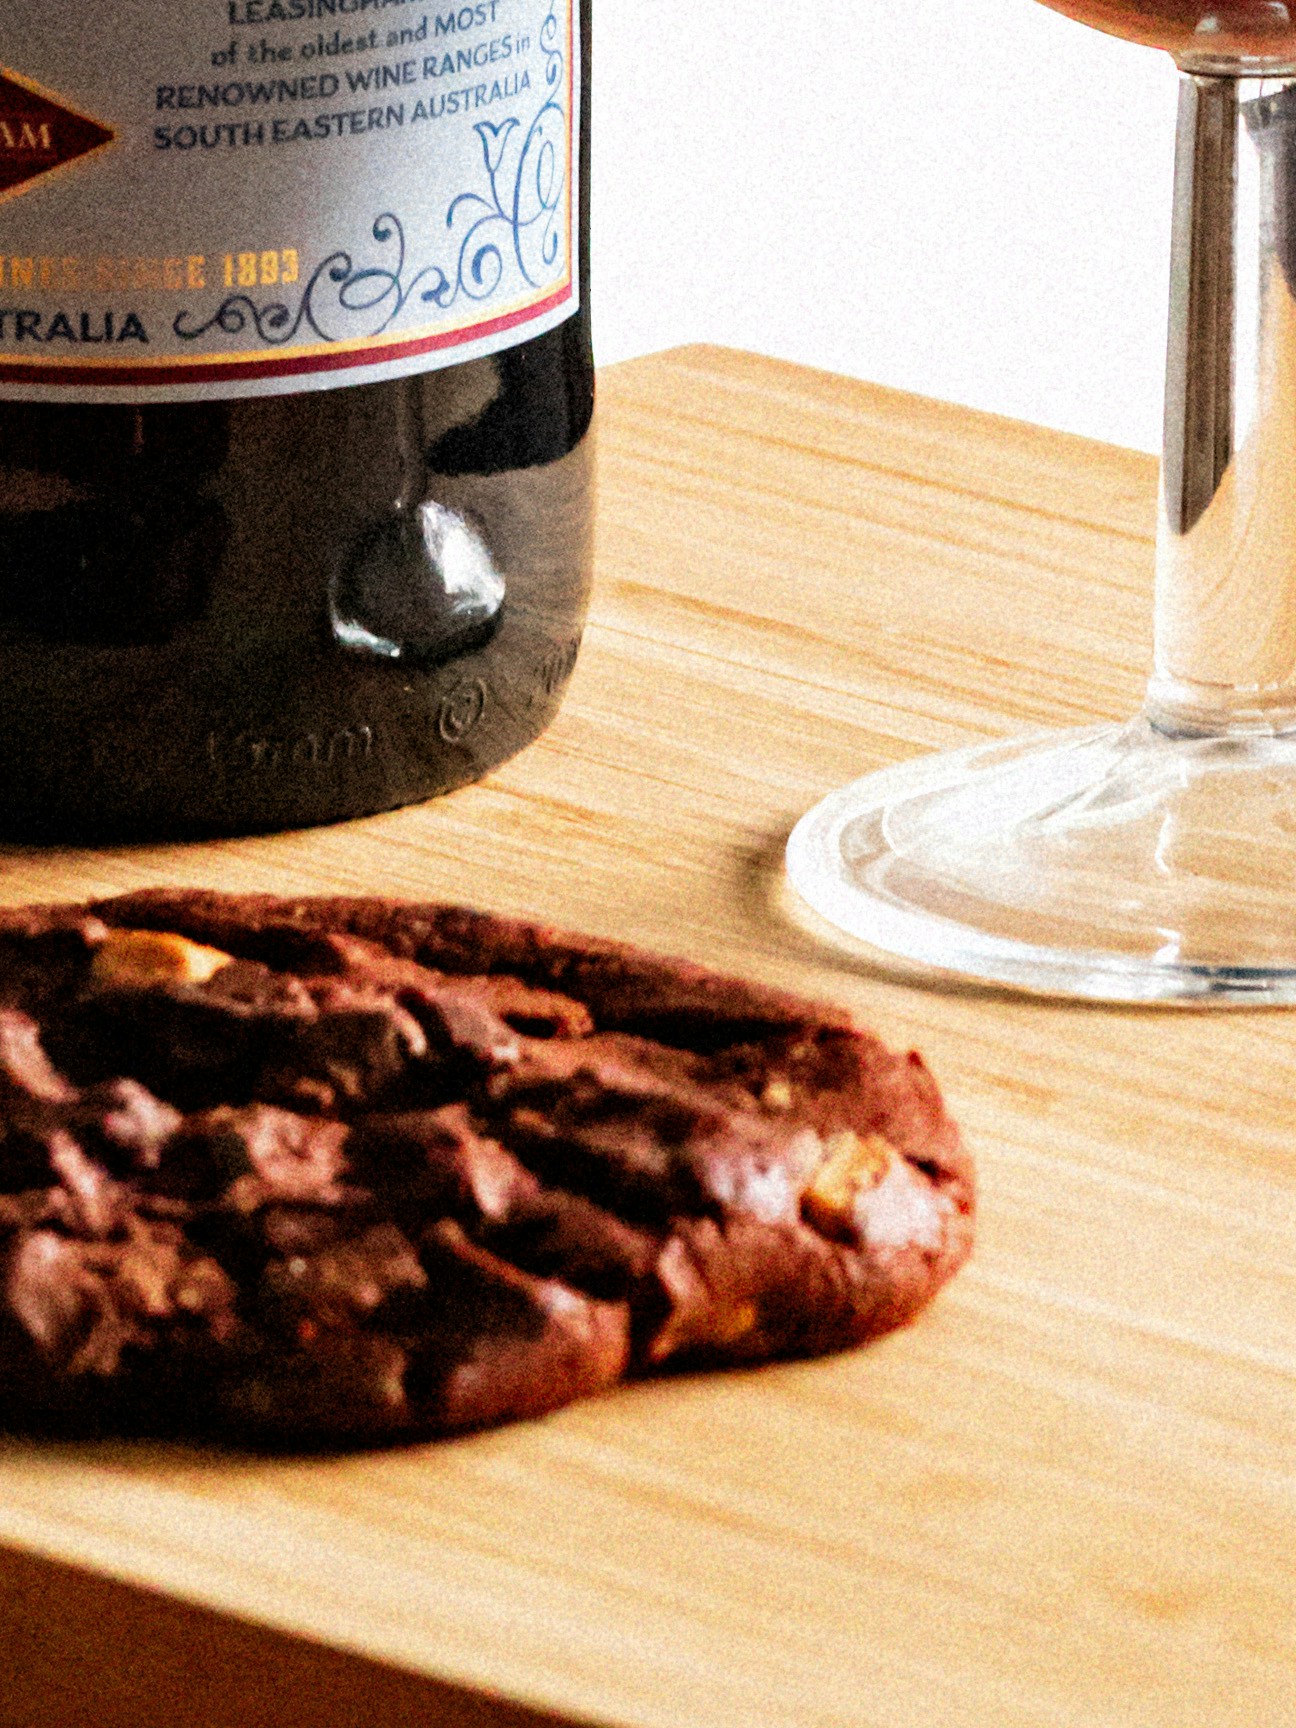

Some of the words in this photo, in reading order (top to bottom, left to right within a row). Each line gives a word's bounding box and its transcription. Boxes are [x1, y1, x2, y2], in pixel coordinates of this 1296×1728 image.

[156, 73, 340, 111] RENOWNED
[345, 59, 417, 94] WINE
[423, 39, 514, 78] RANGES
[516, 33, 532, 55] in
[210, 40, 238, 68] of
[247, 38, 293, 65] the
[299, 30, 377, 59] oldest
[386, 15, 427, 47] and
[153, 120, 264, 151] SOUTH
[271, 103, 405, 144] EASTERN
[411, 69, 532, 123] AUSTRALIA
[223, 247, 299, 288] 1893
